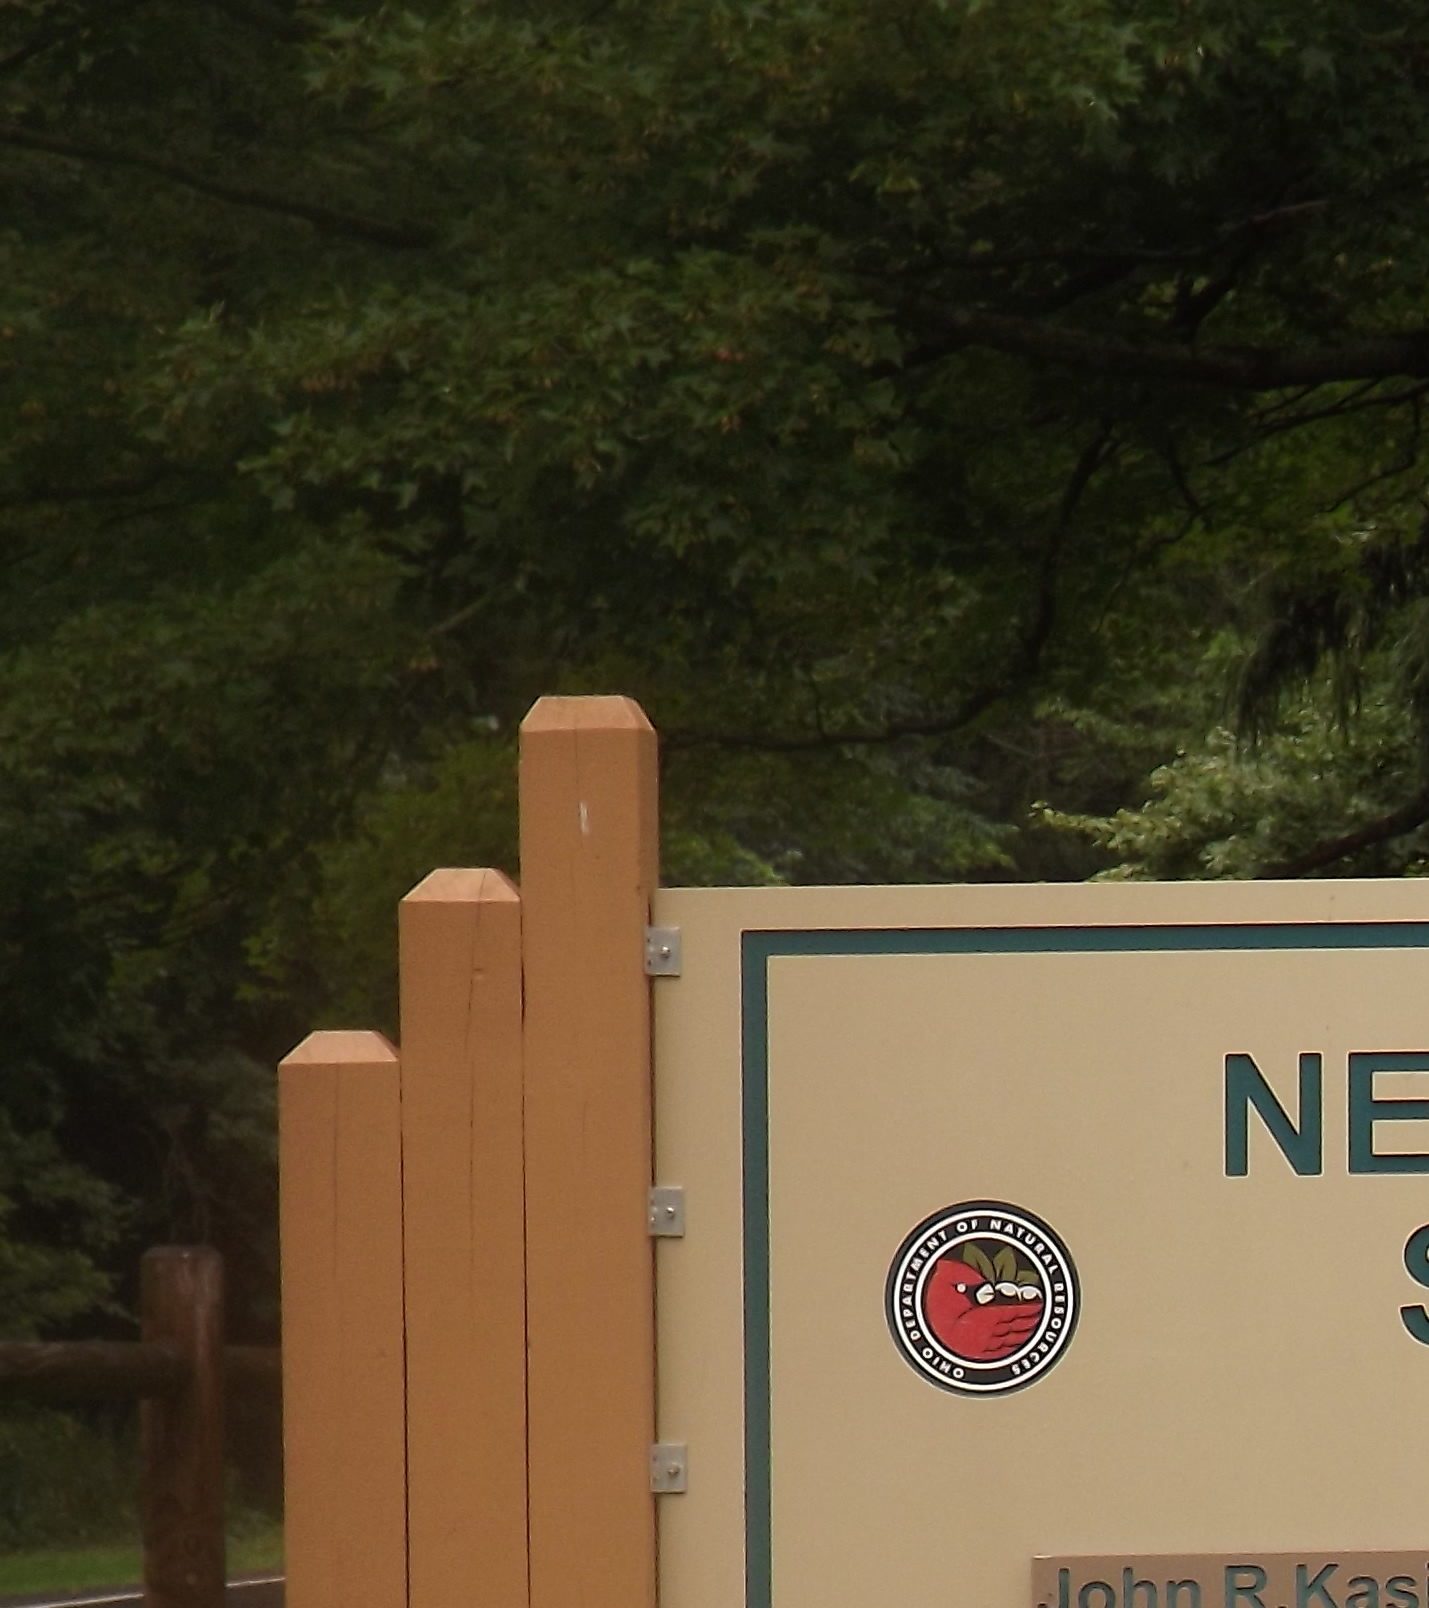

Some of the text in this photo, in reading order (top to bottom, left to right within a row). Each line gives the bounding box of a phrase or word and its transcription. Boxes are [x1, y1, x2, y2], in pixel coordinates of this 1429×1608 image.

[902, 1218, 1066, 1379] OHIO DEPARTMENT OF NATURAL RESOURCES
